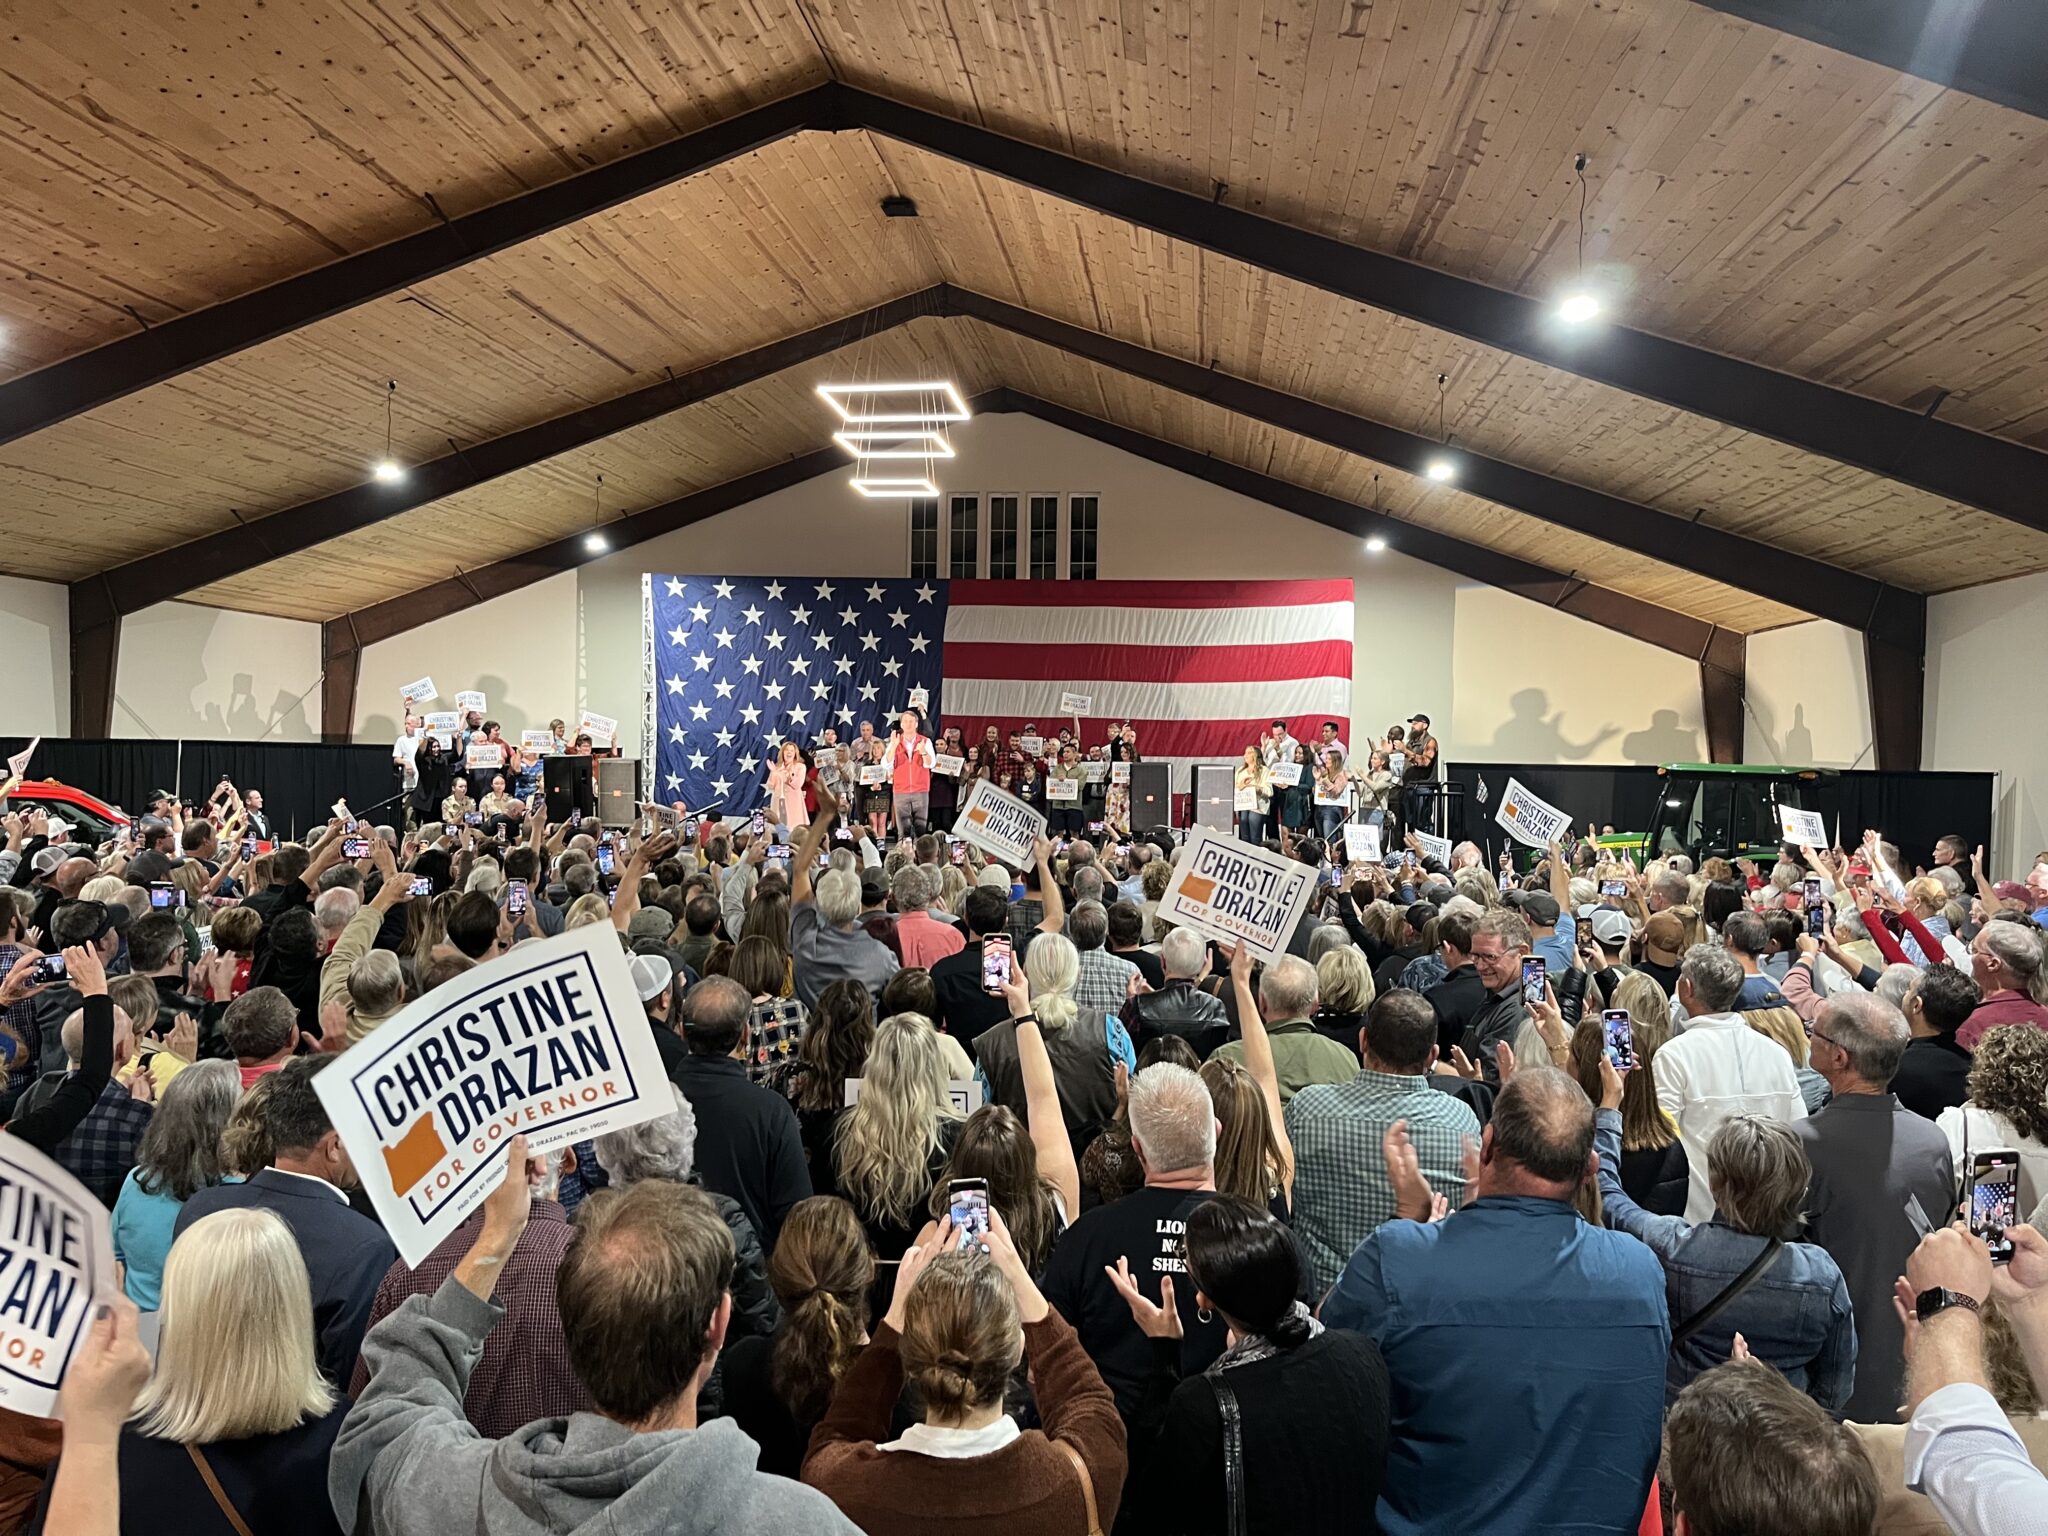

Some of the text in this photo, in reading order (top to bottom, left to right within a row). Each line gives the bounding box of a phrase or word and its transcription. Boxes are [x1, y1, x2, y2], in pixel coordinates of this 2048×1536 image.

[981, 792, 1038, 834] CHRISTINE
[986, 815, 1034, 847] DRAZAN
[1512, 792, 1557, 831] CHRISTINE
[1516, 811, 1550, 841] DRAZAN
[1200, 850, 1297, 907] CHRISTINE
[1184, 901, 1208, 916] FOR
[1215, 914, 1273, 945] GOVERNOR
[1213, 885, 1286, 934] DRAZAN
[374, 970, 592, 1128] CHRISTINE
[437, 1025, 611, 1146] DRAZAN
[424, 1081, 618, 1202] FOR GOVERNOR
